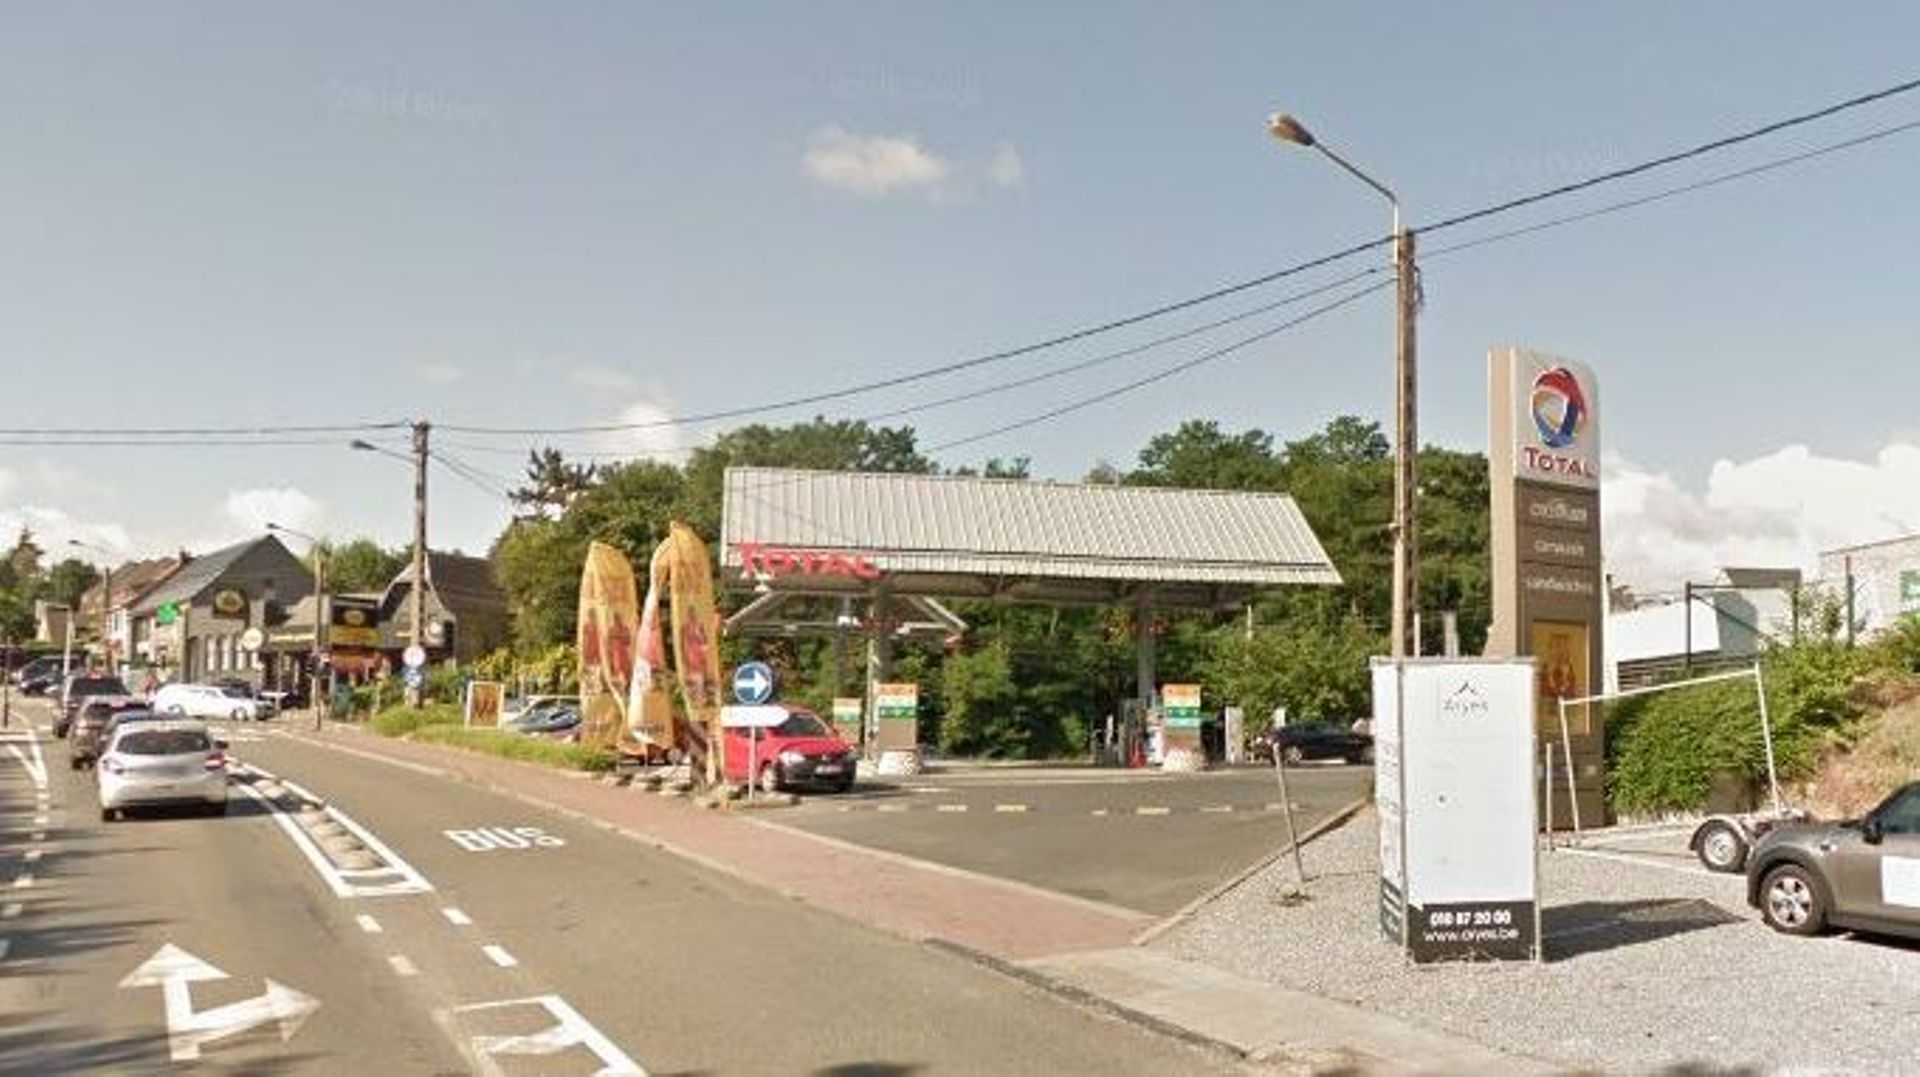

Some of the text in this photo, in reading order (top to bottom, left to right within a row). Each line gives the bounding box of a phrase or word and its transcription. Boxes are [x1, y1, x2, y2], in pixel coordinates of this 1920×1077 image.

[1524, 447, 1598, 479] TOTAL
[739, 541, 888, 581] TOTAL
[442, 827, 565, 852] BUS
